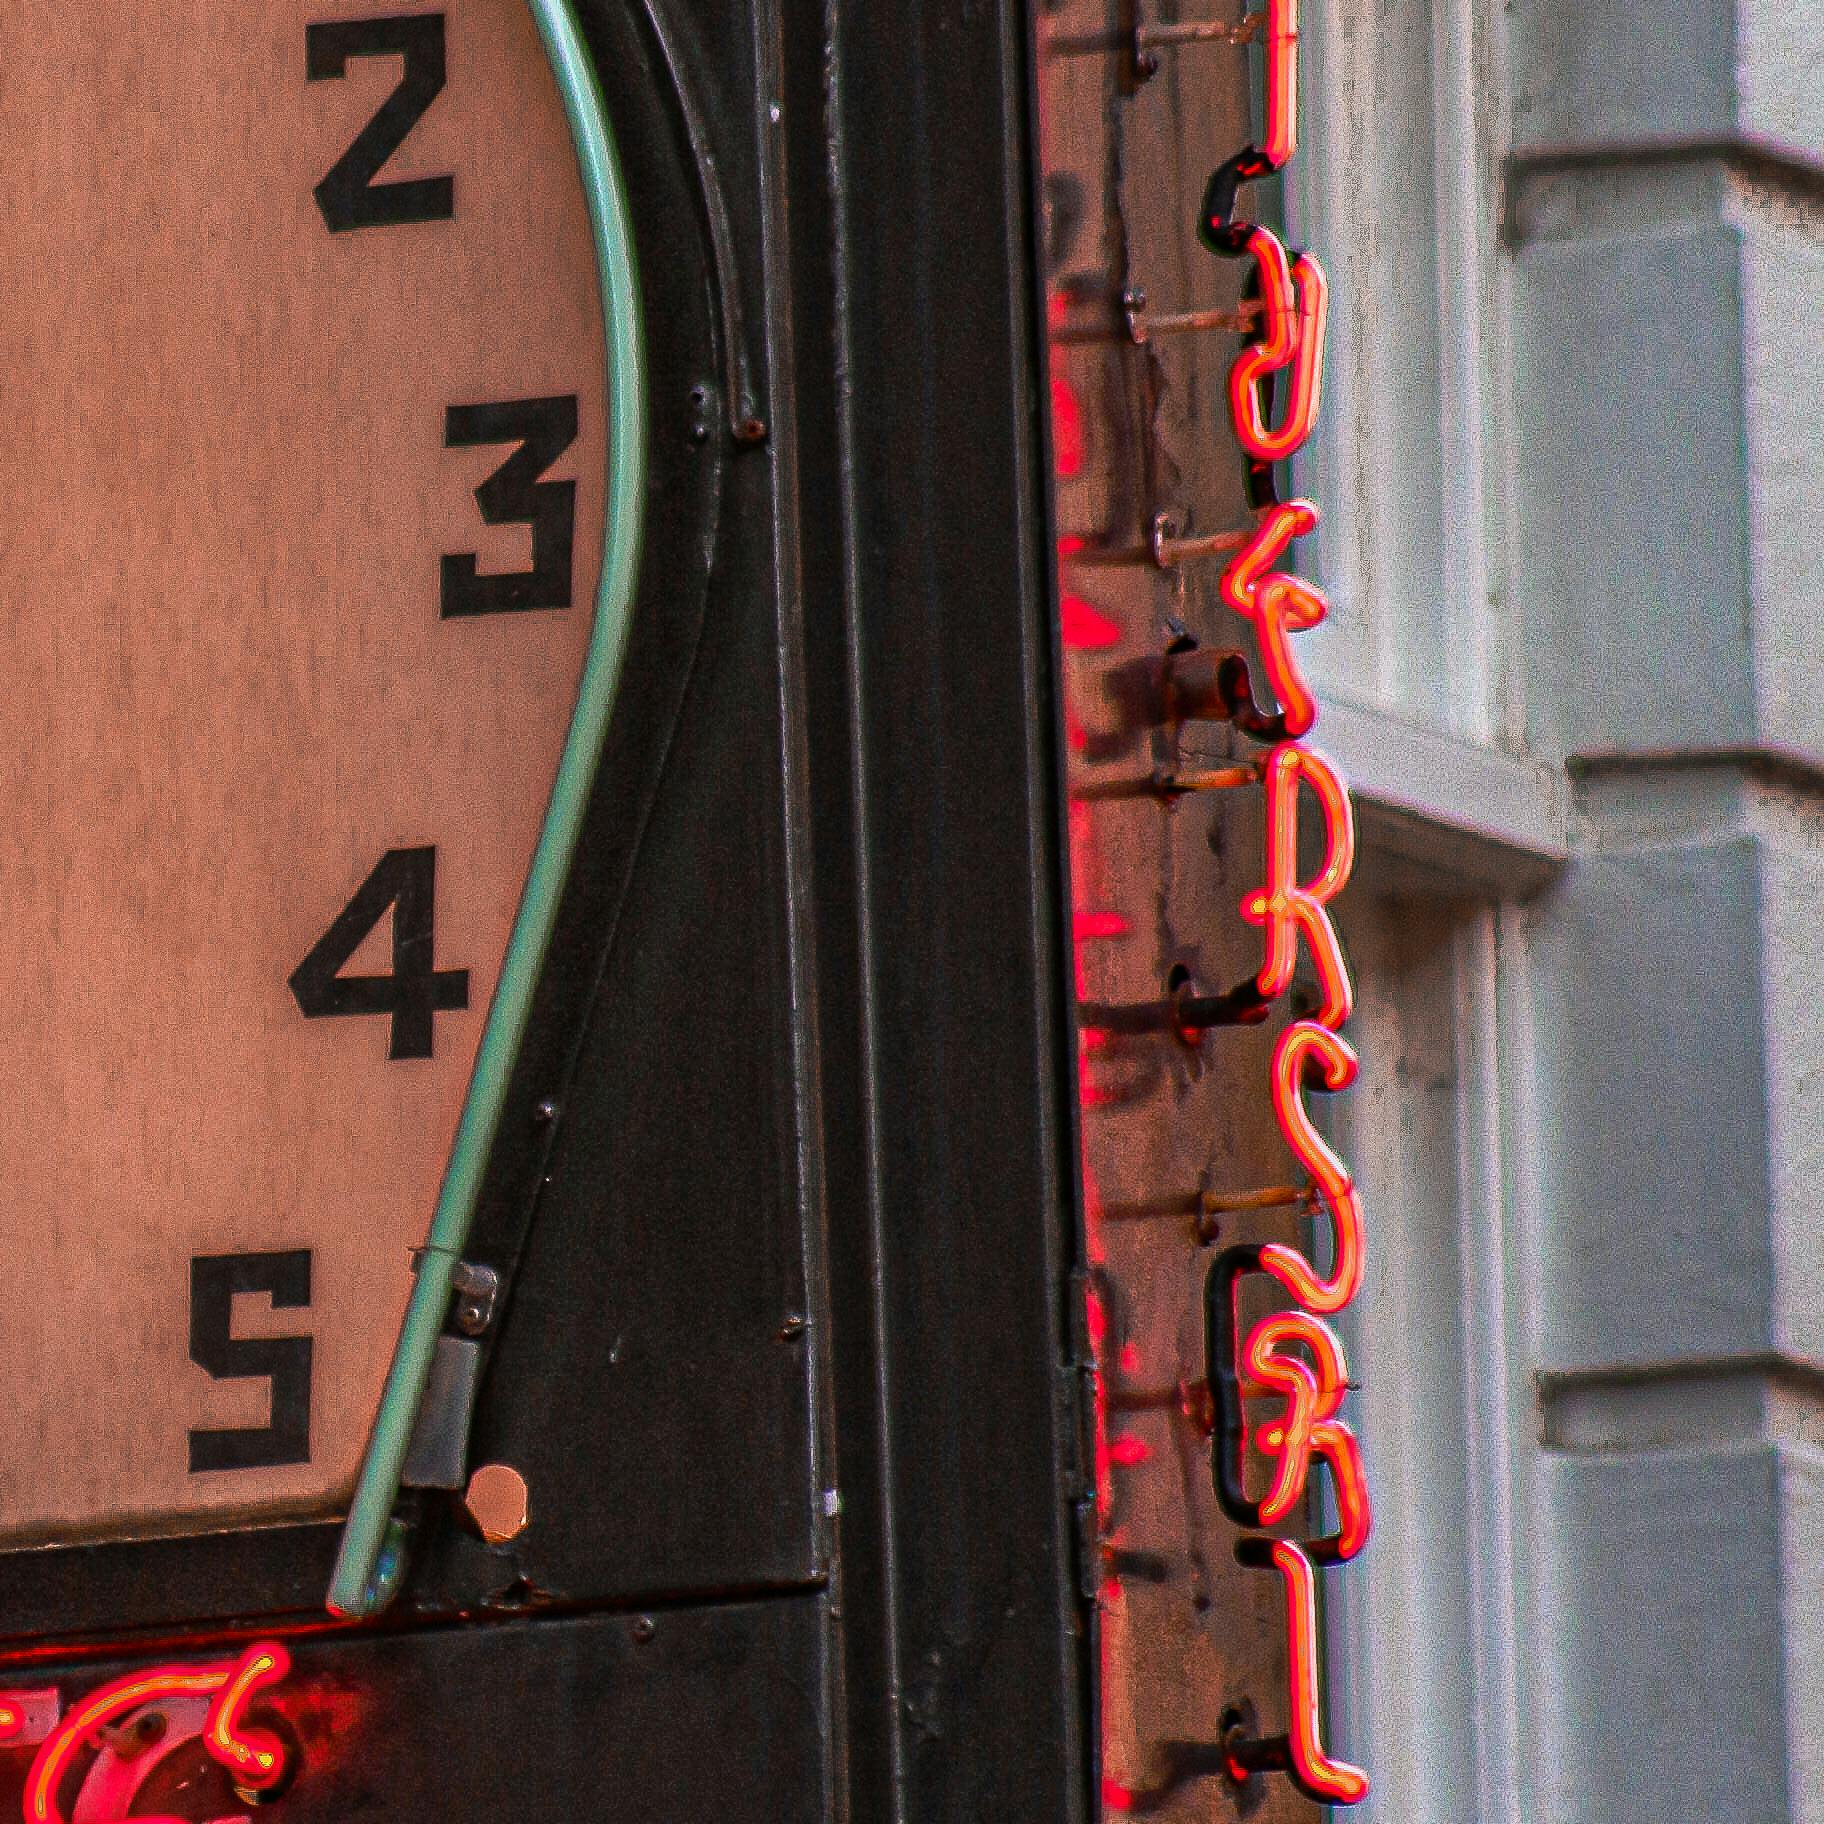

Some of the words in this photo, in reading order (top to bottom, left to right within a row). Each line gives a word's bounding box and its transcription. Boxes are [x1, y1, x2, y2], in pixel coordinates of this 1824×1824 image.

[305, 13, 454, 233] 2
[440, 394, 579, 618] 3
[287, 845, 469, 1059] 4
[187, 1249, 315, 1473] 5
